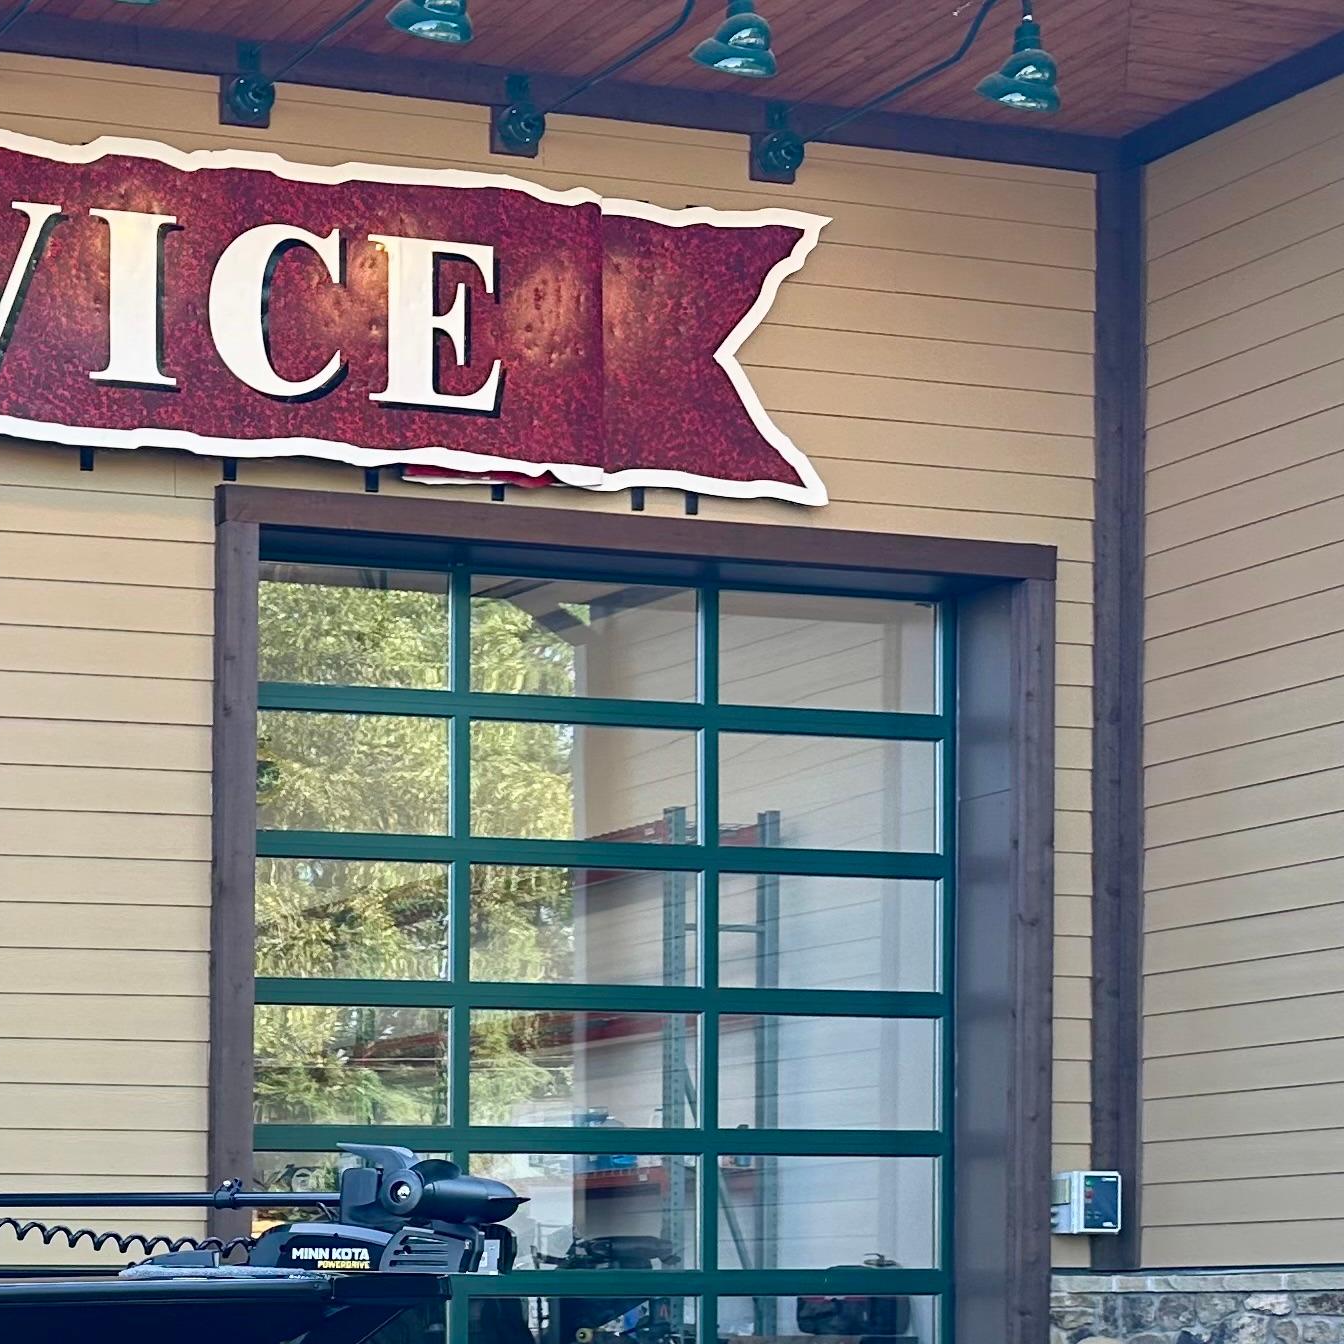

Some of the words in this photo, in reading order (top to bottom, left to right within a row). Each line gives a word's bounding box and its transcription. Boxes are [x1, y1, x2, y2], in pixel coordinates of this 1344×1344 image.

[291, 1247, 330, 1260] MINN
[331, 1247, 370, 1260] KOTA
[317, 1260, 371, 1269] POWERDRIVE
